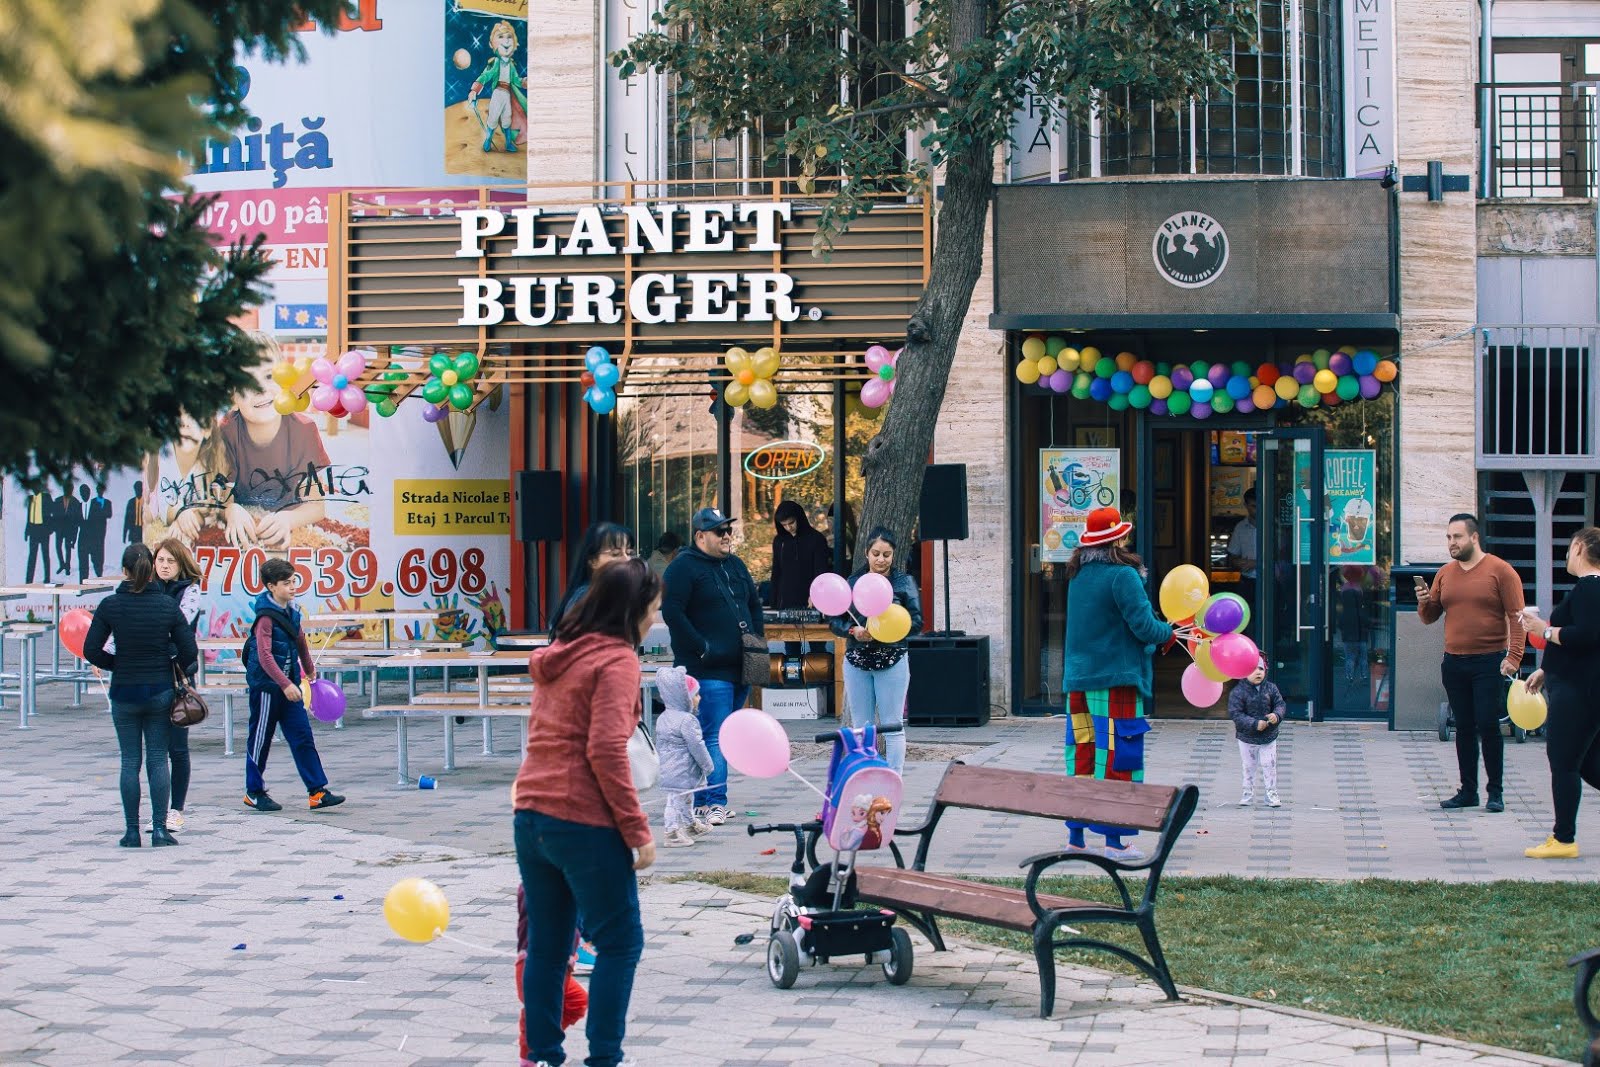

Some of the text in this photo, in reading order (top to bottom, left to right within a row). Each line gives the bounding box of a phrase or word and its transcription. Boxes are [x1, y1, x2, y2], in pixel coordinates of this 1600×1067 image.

[455, 202, 792, 258] PLANET
[1163, 215, 1214, 233] PLANET
[1170, 269, 1212, 282] URBAN FOOD
[457, 273, 801, 327] BURGER
[754, 449, 814, 469] OPEN
[1325, 457, 1365, 489] COFFEE
[402, 490, 449, 504] Strada
[452, 490, 499, 504] Nicolae
[407, 512, 436, 527] Etaj
[443, 513, 451, 523] 1
[455, 512, 495, 524] Parcul
[48, 604, 72, 613] MKES
